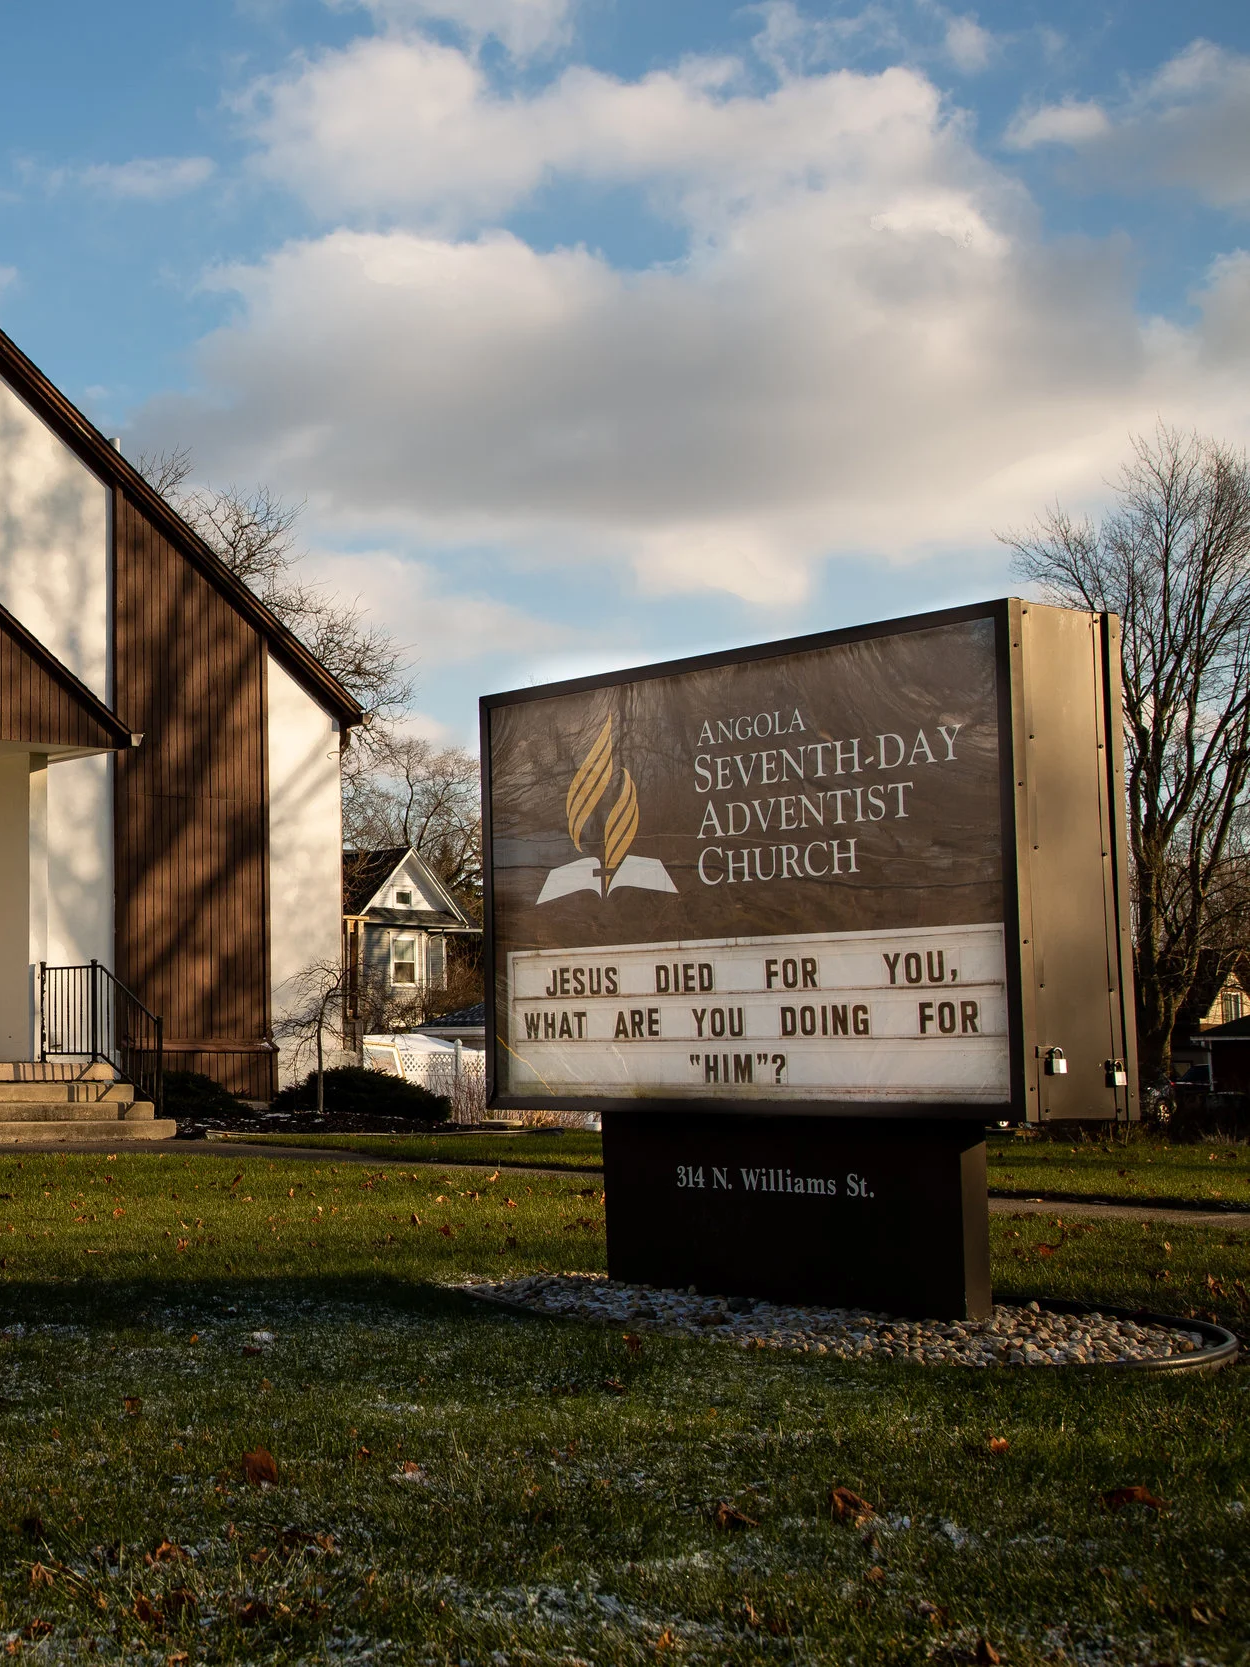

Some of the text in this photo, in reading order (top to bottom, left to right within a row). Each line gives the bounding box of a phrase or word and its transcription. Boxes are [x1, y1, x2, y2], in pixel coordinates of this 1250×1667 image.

[696, 708, 806, 747] ANGOLA
[694, 724, 963, 793] SEVENTH-DAY
[697, 782, 913, 839] ADVENTIST
[697, 838, 860, 885] CHURCH
[545, 952, 958, 997] JESUS DIED FOR YOU,
[524, 1001, 978, 1040] WHAT ARE YOU DOING FOR
[689, 1053, 786, 1084] "HIM"?
[676, 1165, 875, 1198] 314 N. Williams St.
